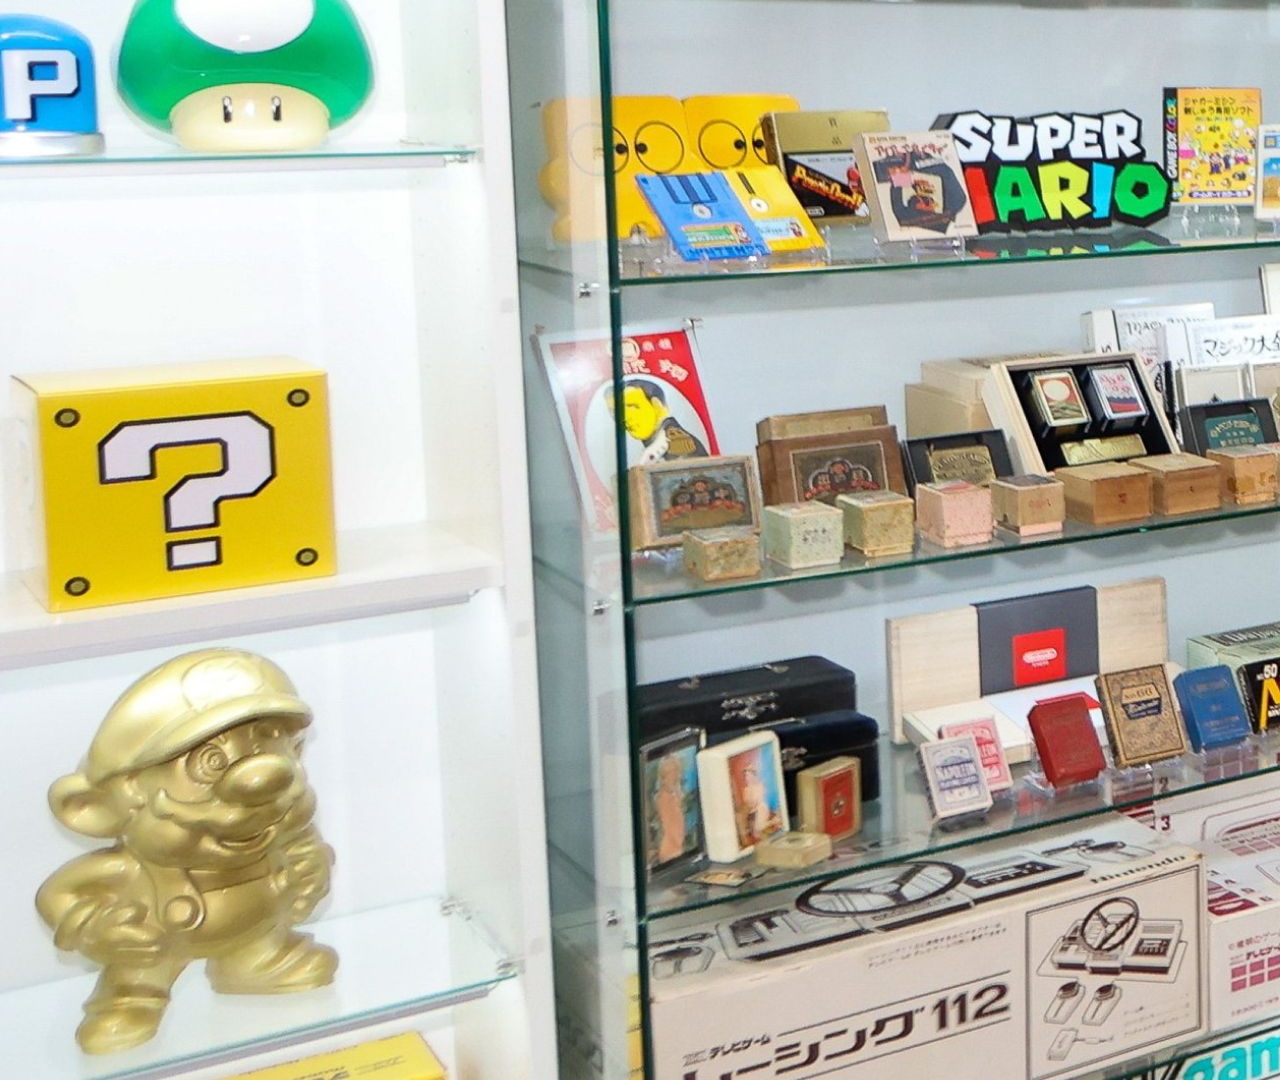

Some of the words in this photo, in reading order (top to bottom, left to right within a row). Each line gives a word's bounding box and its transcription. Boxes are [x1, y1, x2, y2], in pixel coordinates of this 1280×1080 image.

[3, 49, 78, 120] P
[950, 110, 1143, 164] SUPER
[1263, 663, 1279, 679] 50
[1090, 852, 1188, 884] Nintendo
[930, 982, 1011, 1032] 112
